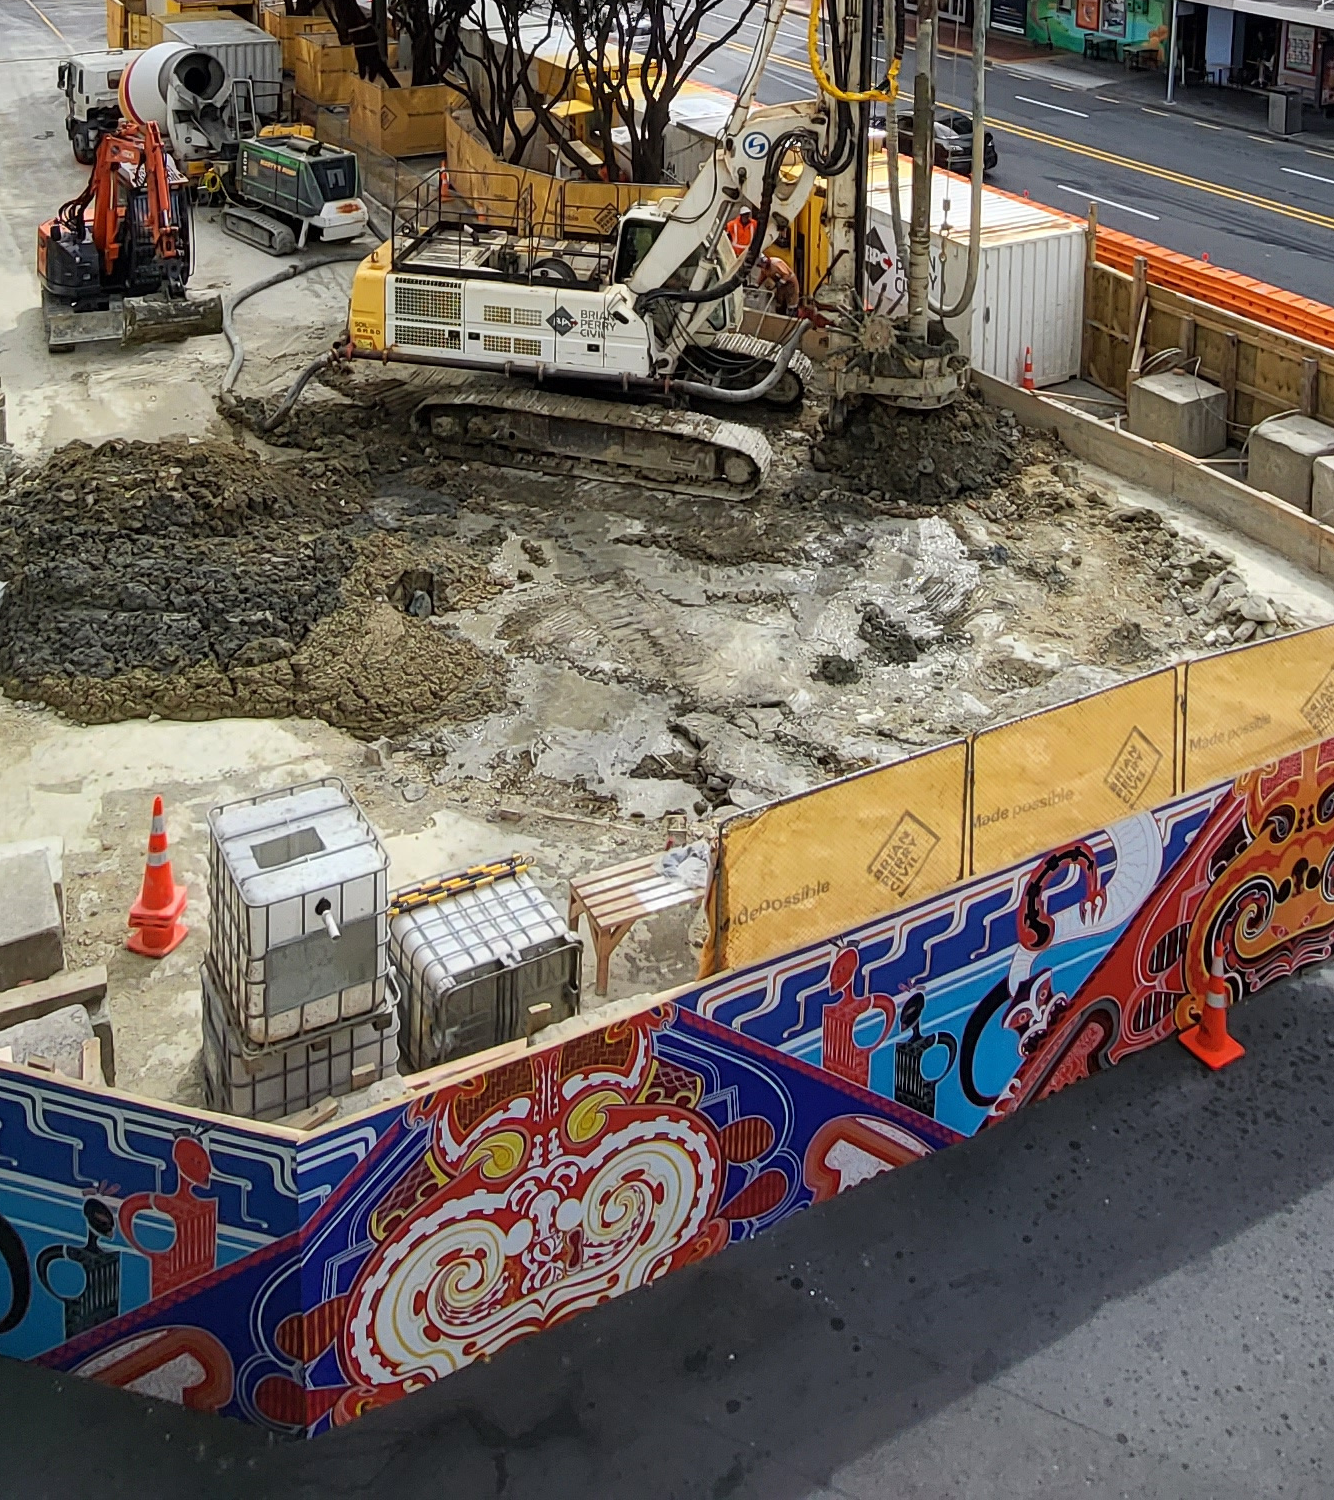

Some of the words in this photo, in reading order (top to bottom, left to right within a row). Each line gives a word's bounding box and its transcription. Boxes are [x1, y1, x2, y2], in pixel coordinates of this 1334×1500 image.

[580, 309, 615, 322] BRIAN
[580, 320, 617, 332] PERRY
[579, 328, 606, 339] CIVIL
[1189, 731, 1225, 751] Made
[1109, 744, 1139, 793] BRIAN
[1013, 787, 1075, 818] possible
[874, 830, 912, 881] BRIAN
[881, 835, 918, 887] PERRY
[890, 855, 922, 892] CIVIL
